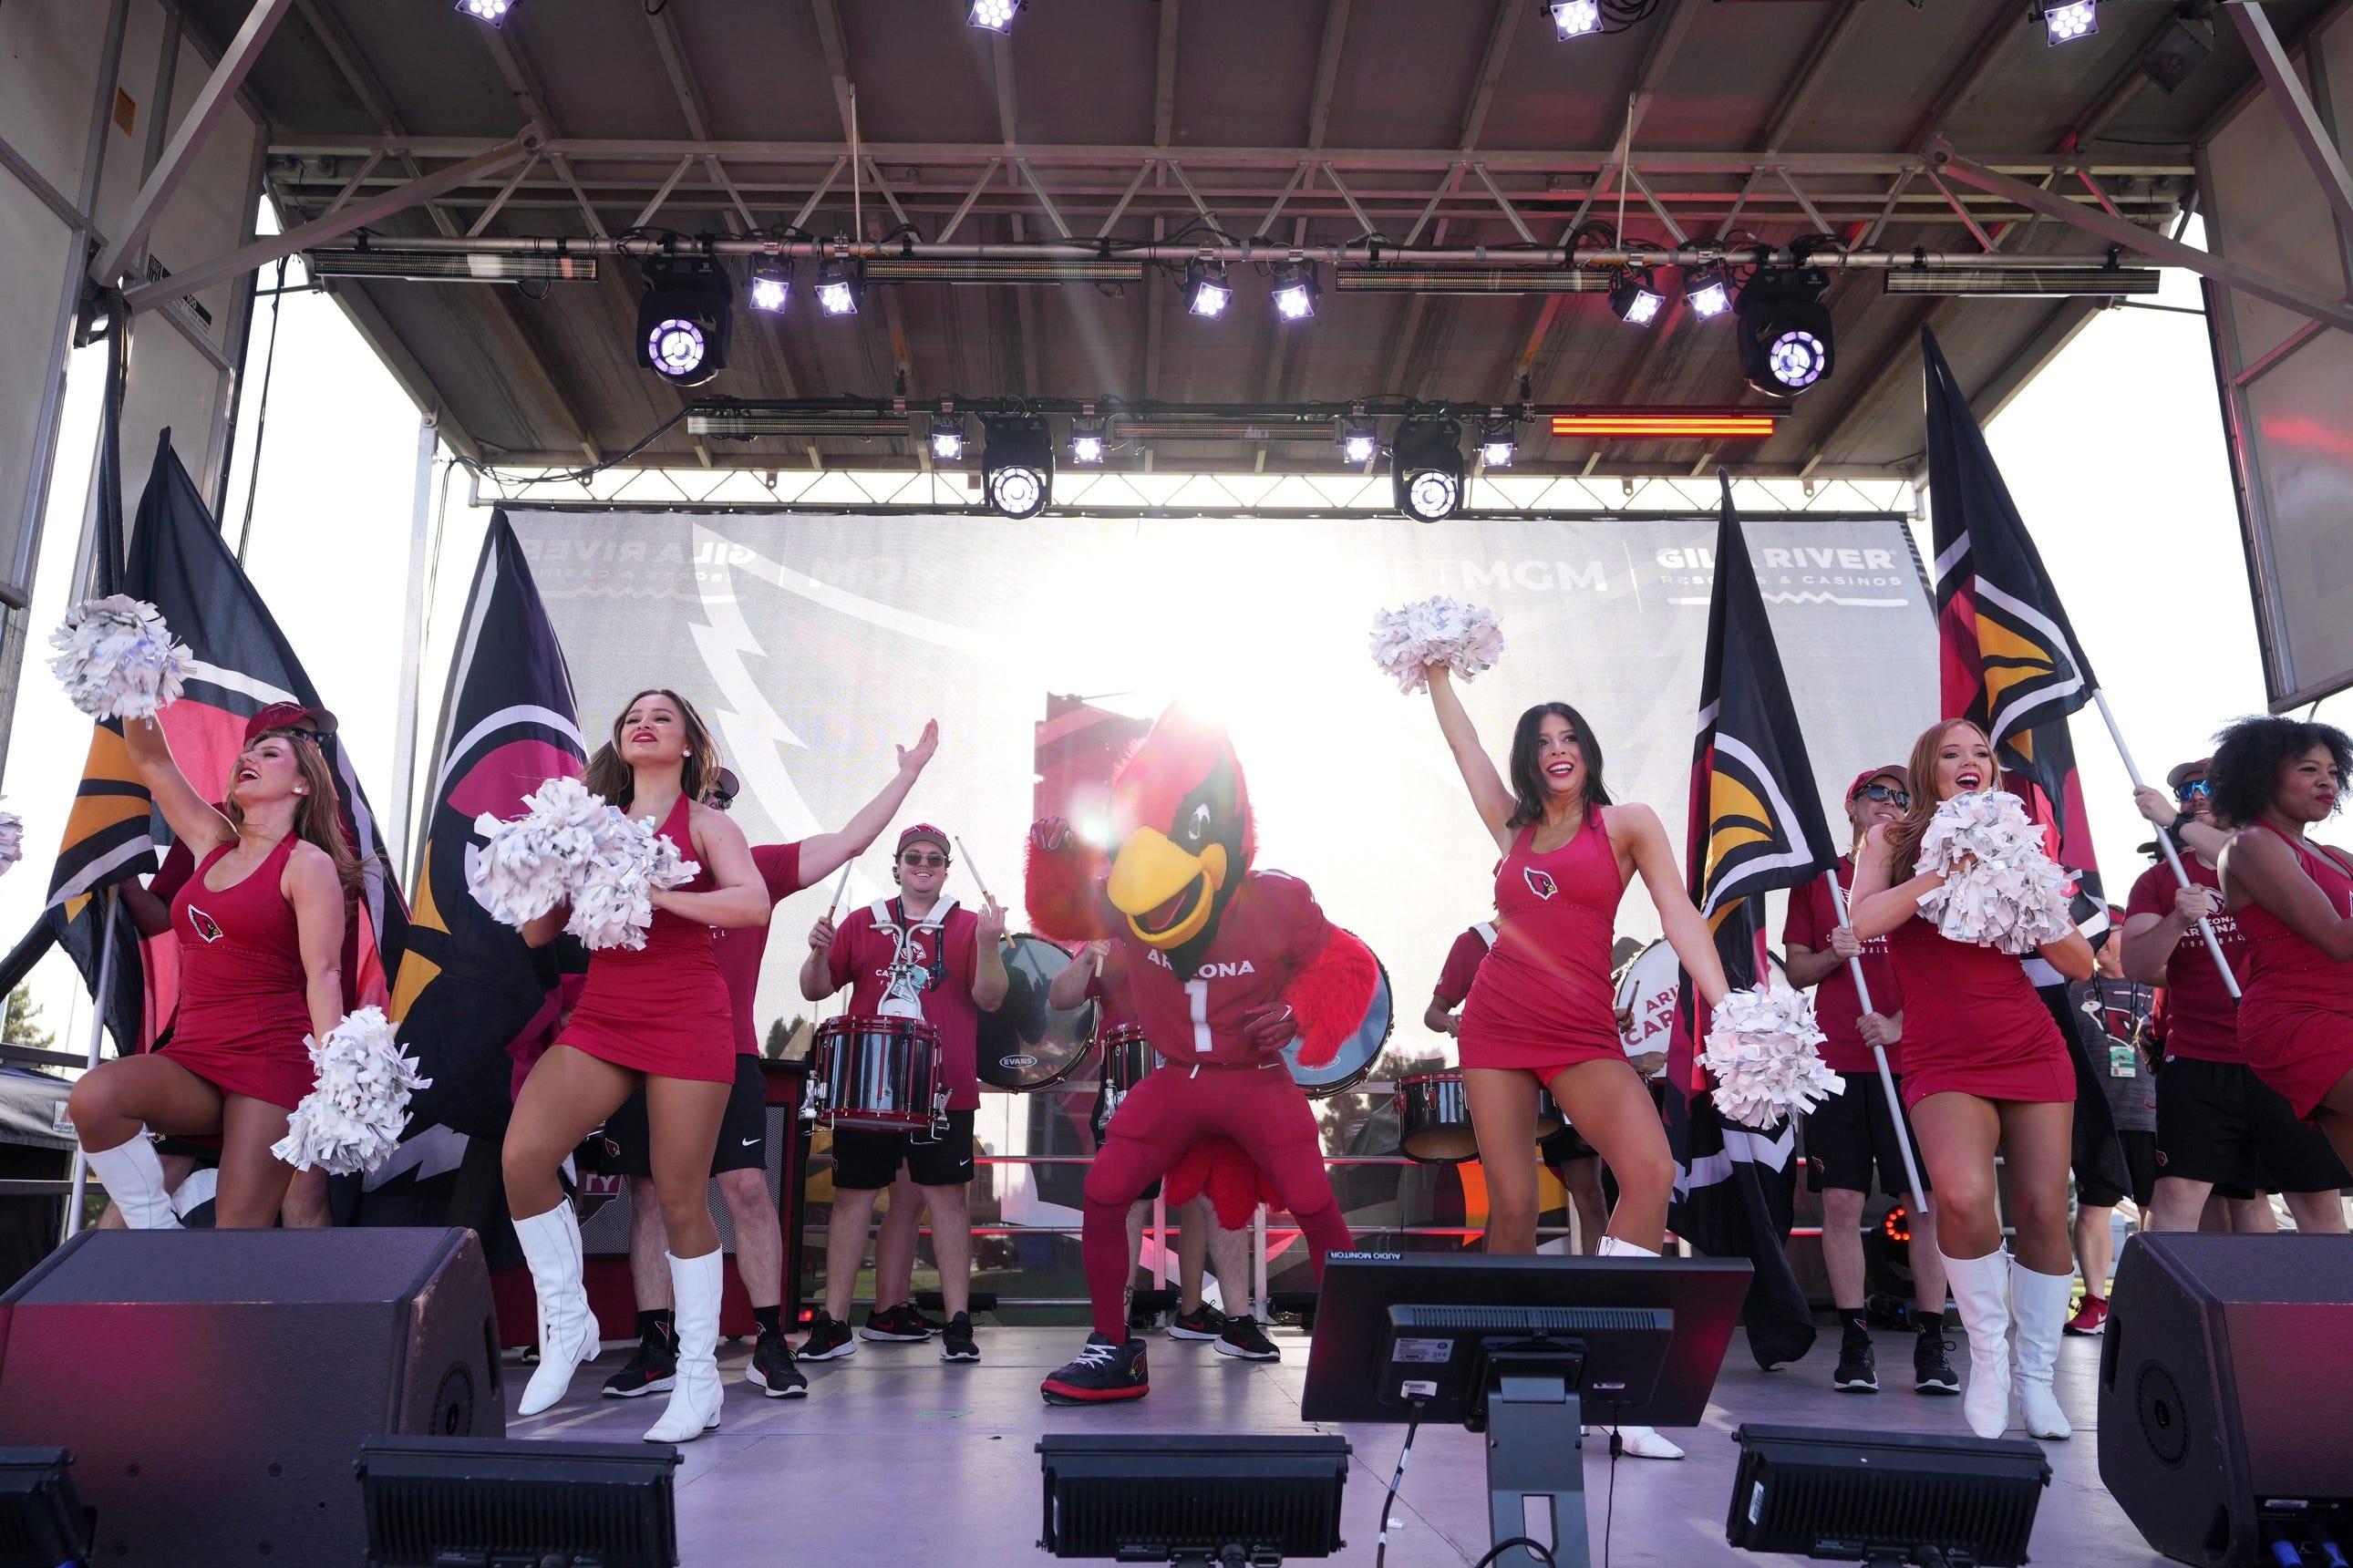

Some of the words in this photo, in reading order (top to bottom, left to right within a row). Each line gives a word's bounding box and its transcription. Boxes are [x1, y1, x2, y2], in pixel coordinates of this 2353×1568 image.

[1763, 548, 1895, 570] RIVER
[1781, 575, 1793, 584] &
[1802, 575, 1903, 586] CASINOS
[1861, 946, 1889, 954] BALL
[1147, 948, 1255, 978] ARONA
[1646, 986, 1677, 1014] ARI
[1184, 978, 1213, 1053] 1
[1624, 1009, 1675, 1046] CAR
[1003, 1057, 1032, 1066] EVANS
[585, 1173, 616, 1192] TY
[1330, 1250, 1372, 1259] MONITOR
[1373, 1252, 1401, 1261] AUDIO
